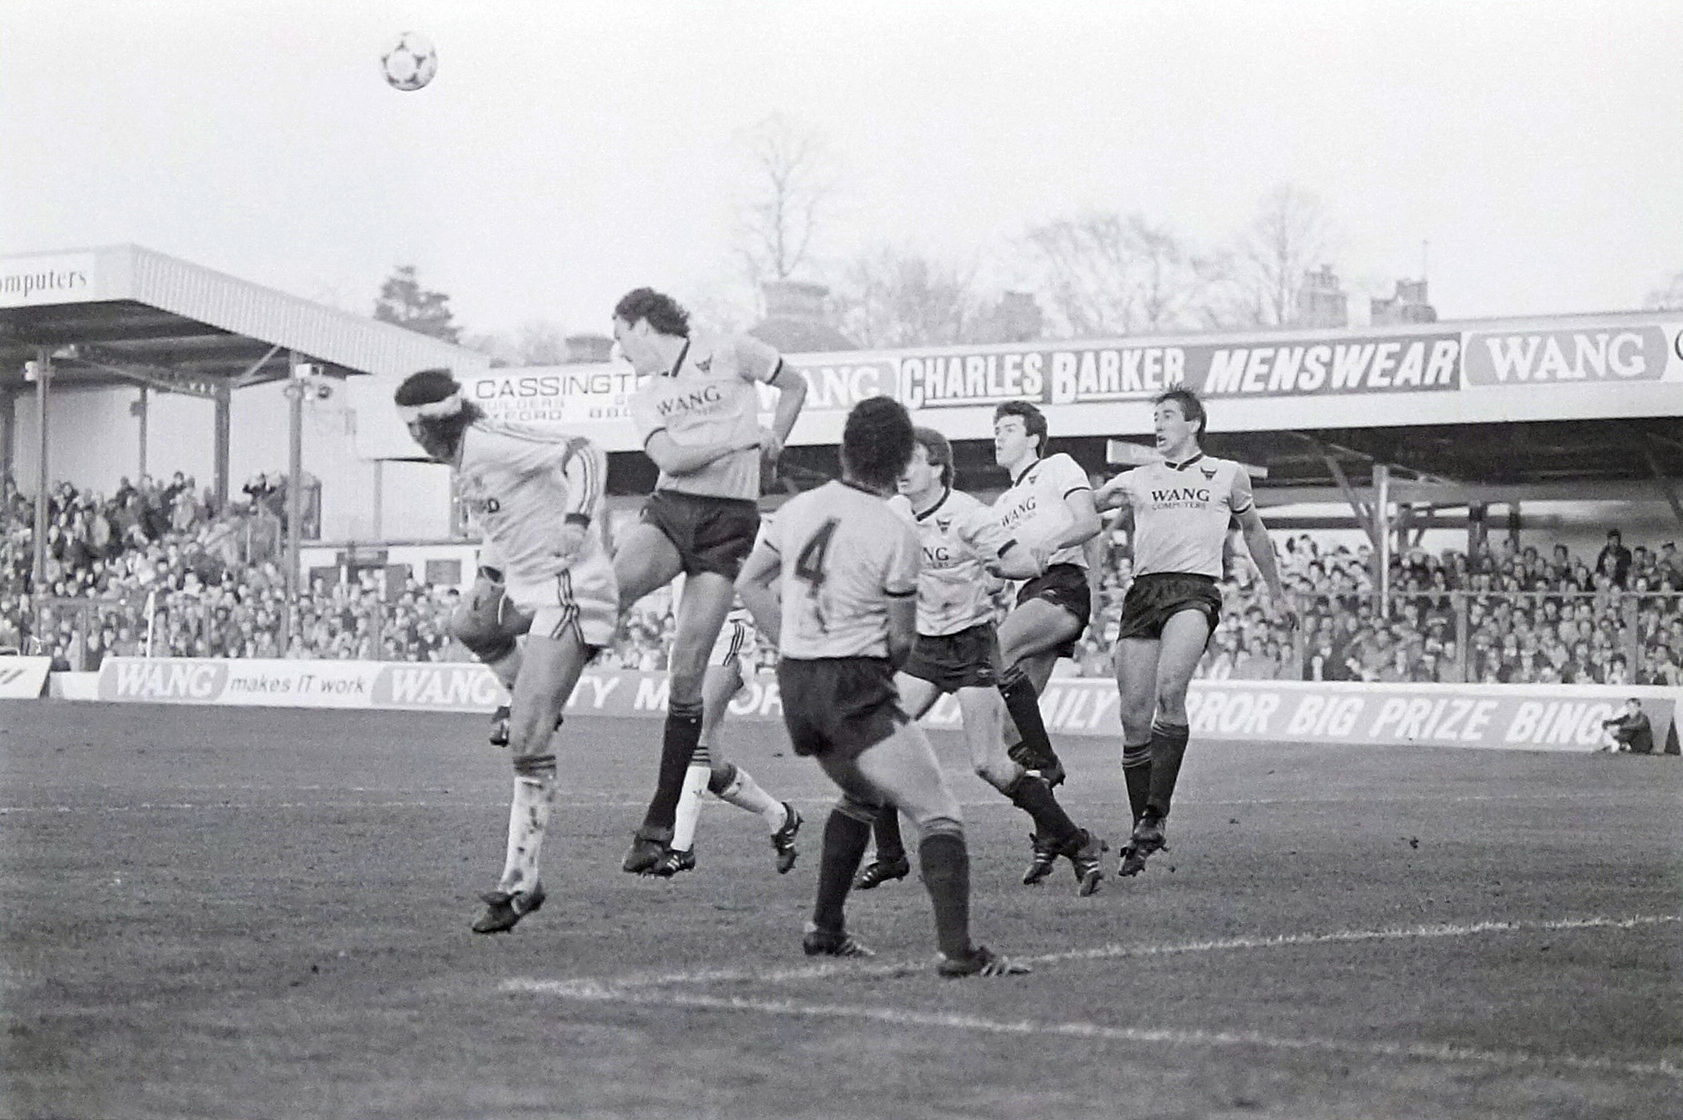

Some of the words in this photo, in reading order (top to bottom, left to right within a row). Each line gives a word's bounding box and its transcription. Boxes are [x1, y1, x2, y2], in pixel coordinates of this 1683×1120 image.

[0, 269, 87, 297] mputers
[1486, 333, 1647, 381] WANG
[476, 373, 640, 399] CASSINGT
[902, 352, 1043, 409] CHARLES
[1051, 348, 1186, 404] BARKER
[1203, 339, 1459, 393] MENSWEAR
[656, 385, 721, 417] WANG
[1151, 488, 1210, 502] WANG
[1001, 496, 1036, 528] WANG
[796, 516, 841, 598] 4
[116, 662, 217, 697] WANG
[230, 675, 291, 693] makes
[297, 675, 316, 693] IT
[321, 675, 364, 693] work
[391, 668, 499, 705] WANG
[1286, 693, 1365, 738] BIG
[1368, 697, 1498, 741] PRIZE
